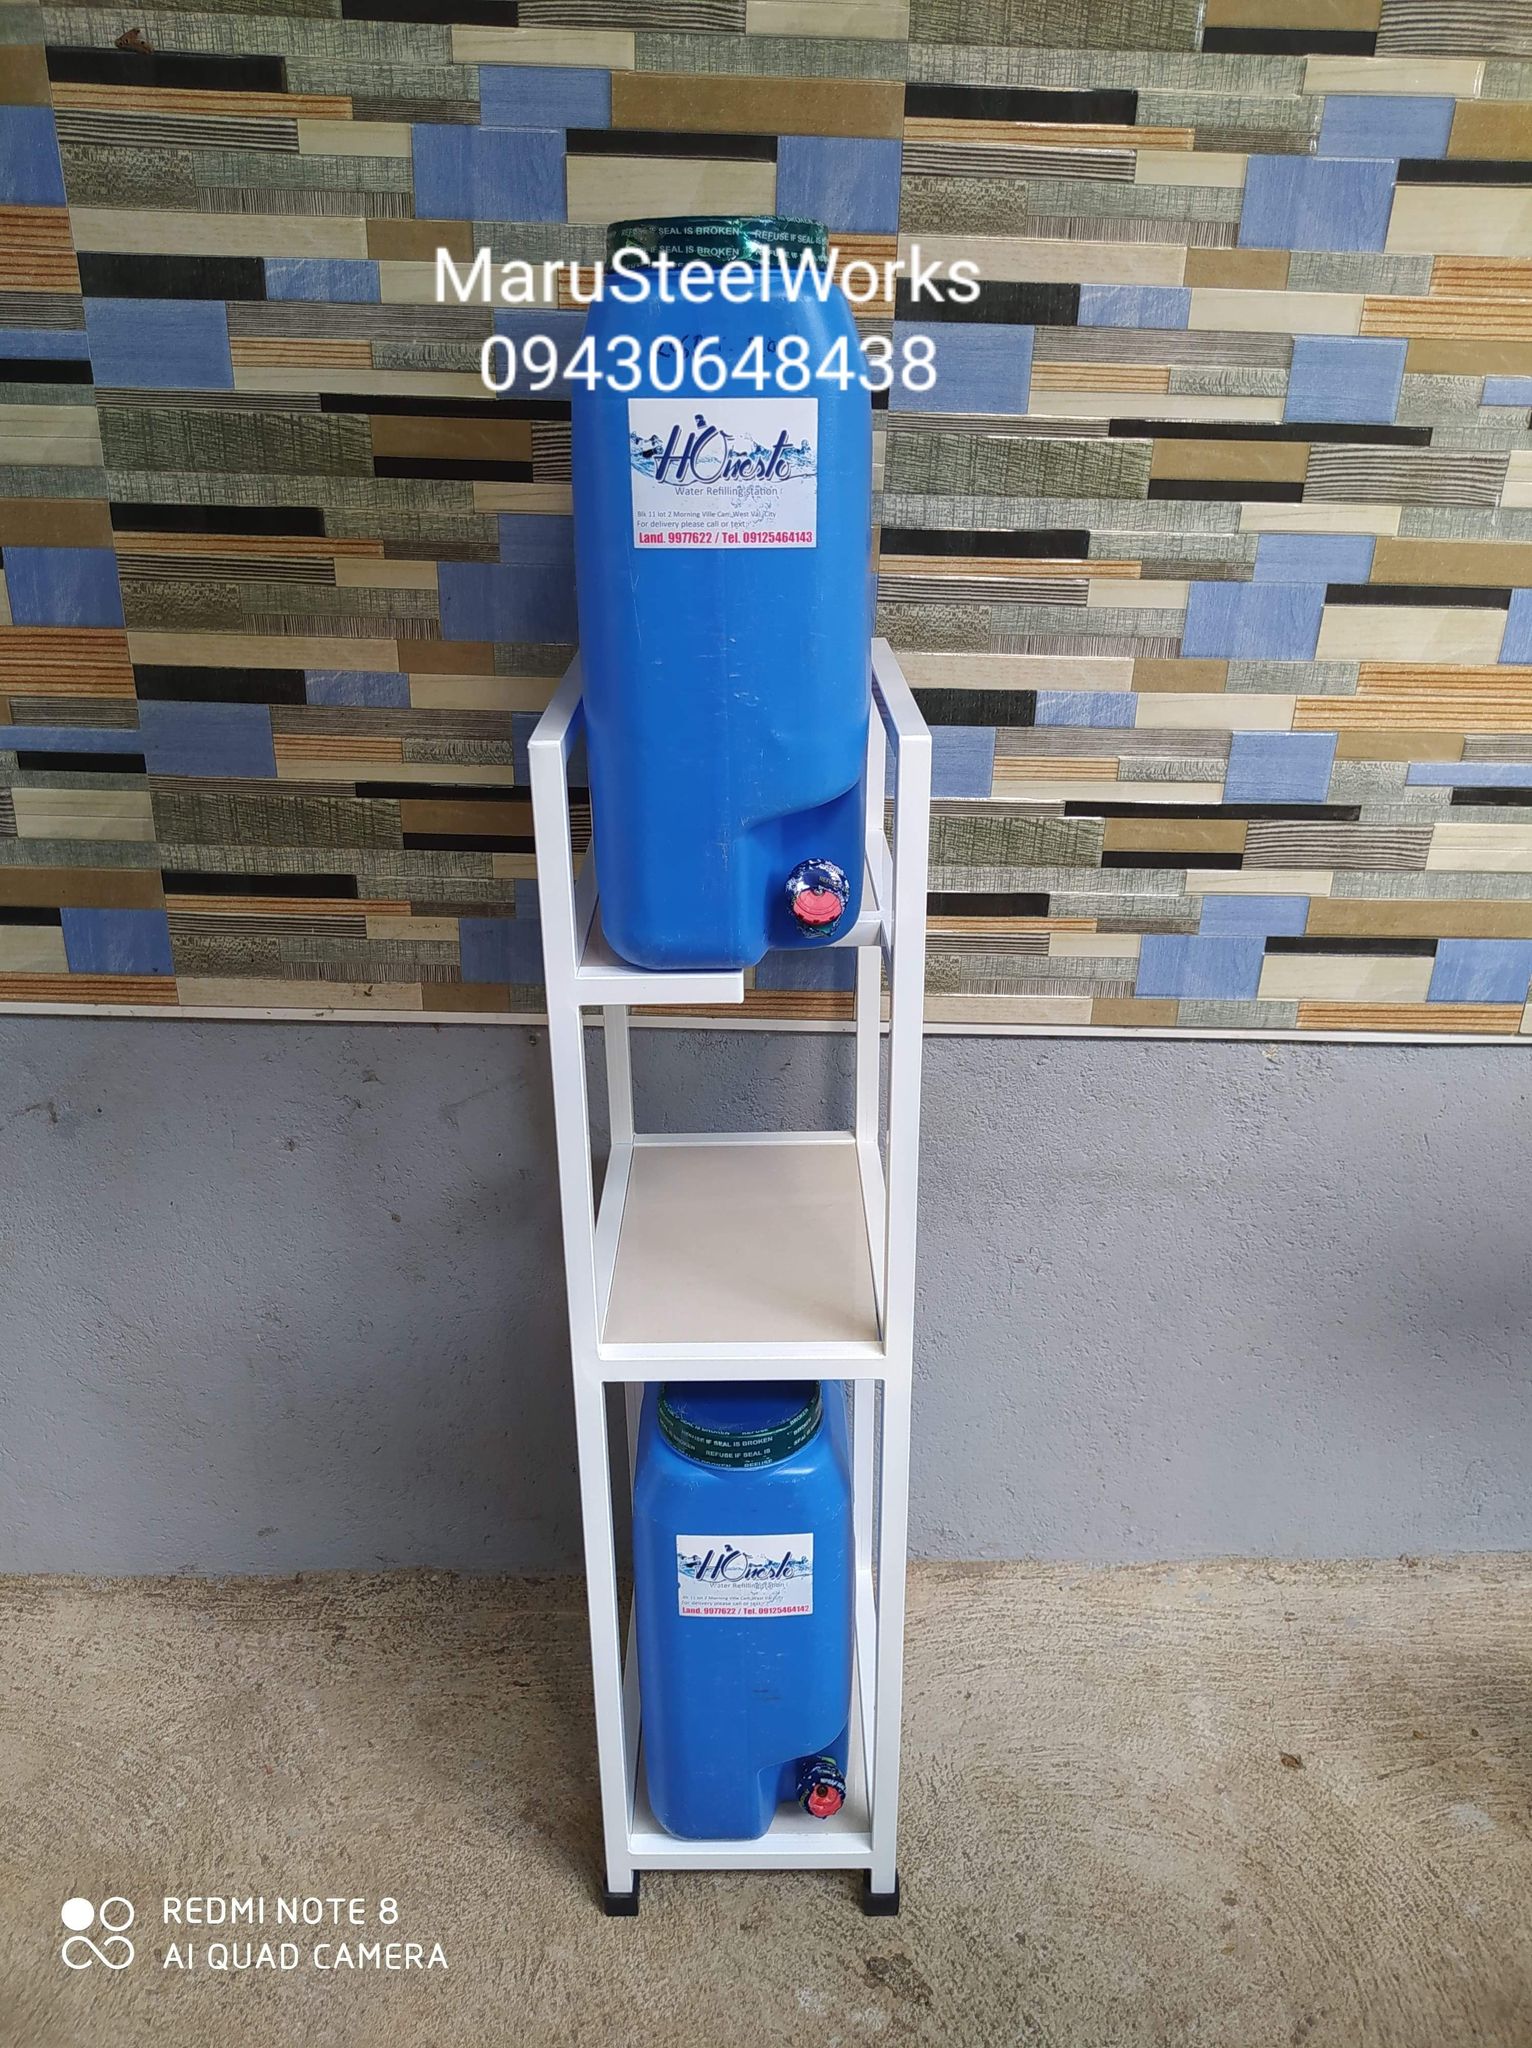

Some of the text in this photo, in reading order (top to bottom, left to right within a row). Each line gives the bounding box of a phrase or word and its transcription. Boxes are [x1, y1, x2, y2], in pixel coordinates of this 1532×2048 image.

[658, 226, 682, 235] SEAL
[684, 226, 693, 235] IS
[695, 225, 740, 236] BROKEN
[755, 229, 789, 242] REFUSE
[797, 234, 814, 244] SEAL
[659, 244, 683, 254] SEAL
[685, 245, 695, 254] IS
[696, 246, 740, 257] BROKEN
[675, 486, 704, 496] Water
[706, 486, 744, 497] Refilling
[673, 511, 700, 519] Morning
[650, 521, 680, 529] delivery
[681, 521, 705, 529] please
[639, 532, 666, 544] Land.
[668, 532, 712, 544] 9977622
[722, 532, 741, 544] Tel.
[743, 531, 813, 544] 09125464143
[713, 1440, 732, 1448] SEAL
[742, 1436, 773, 1447] BROKEN
[705, 1449, 734, 1459] REFUSE
